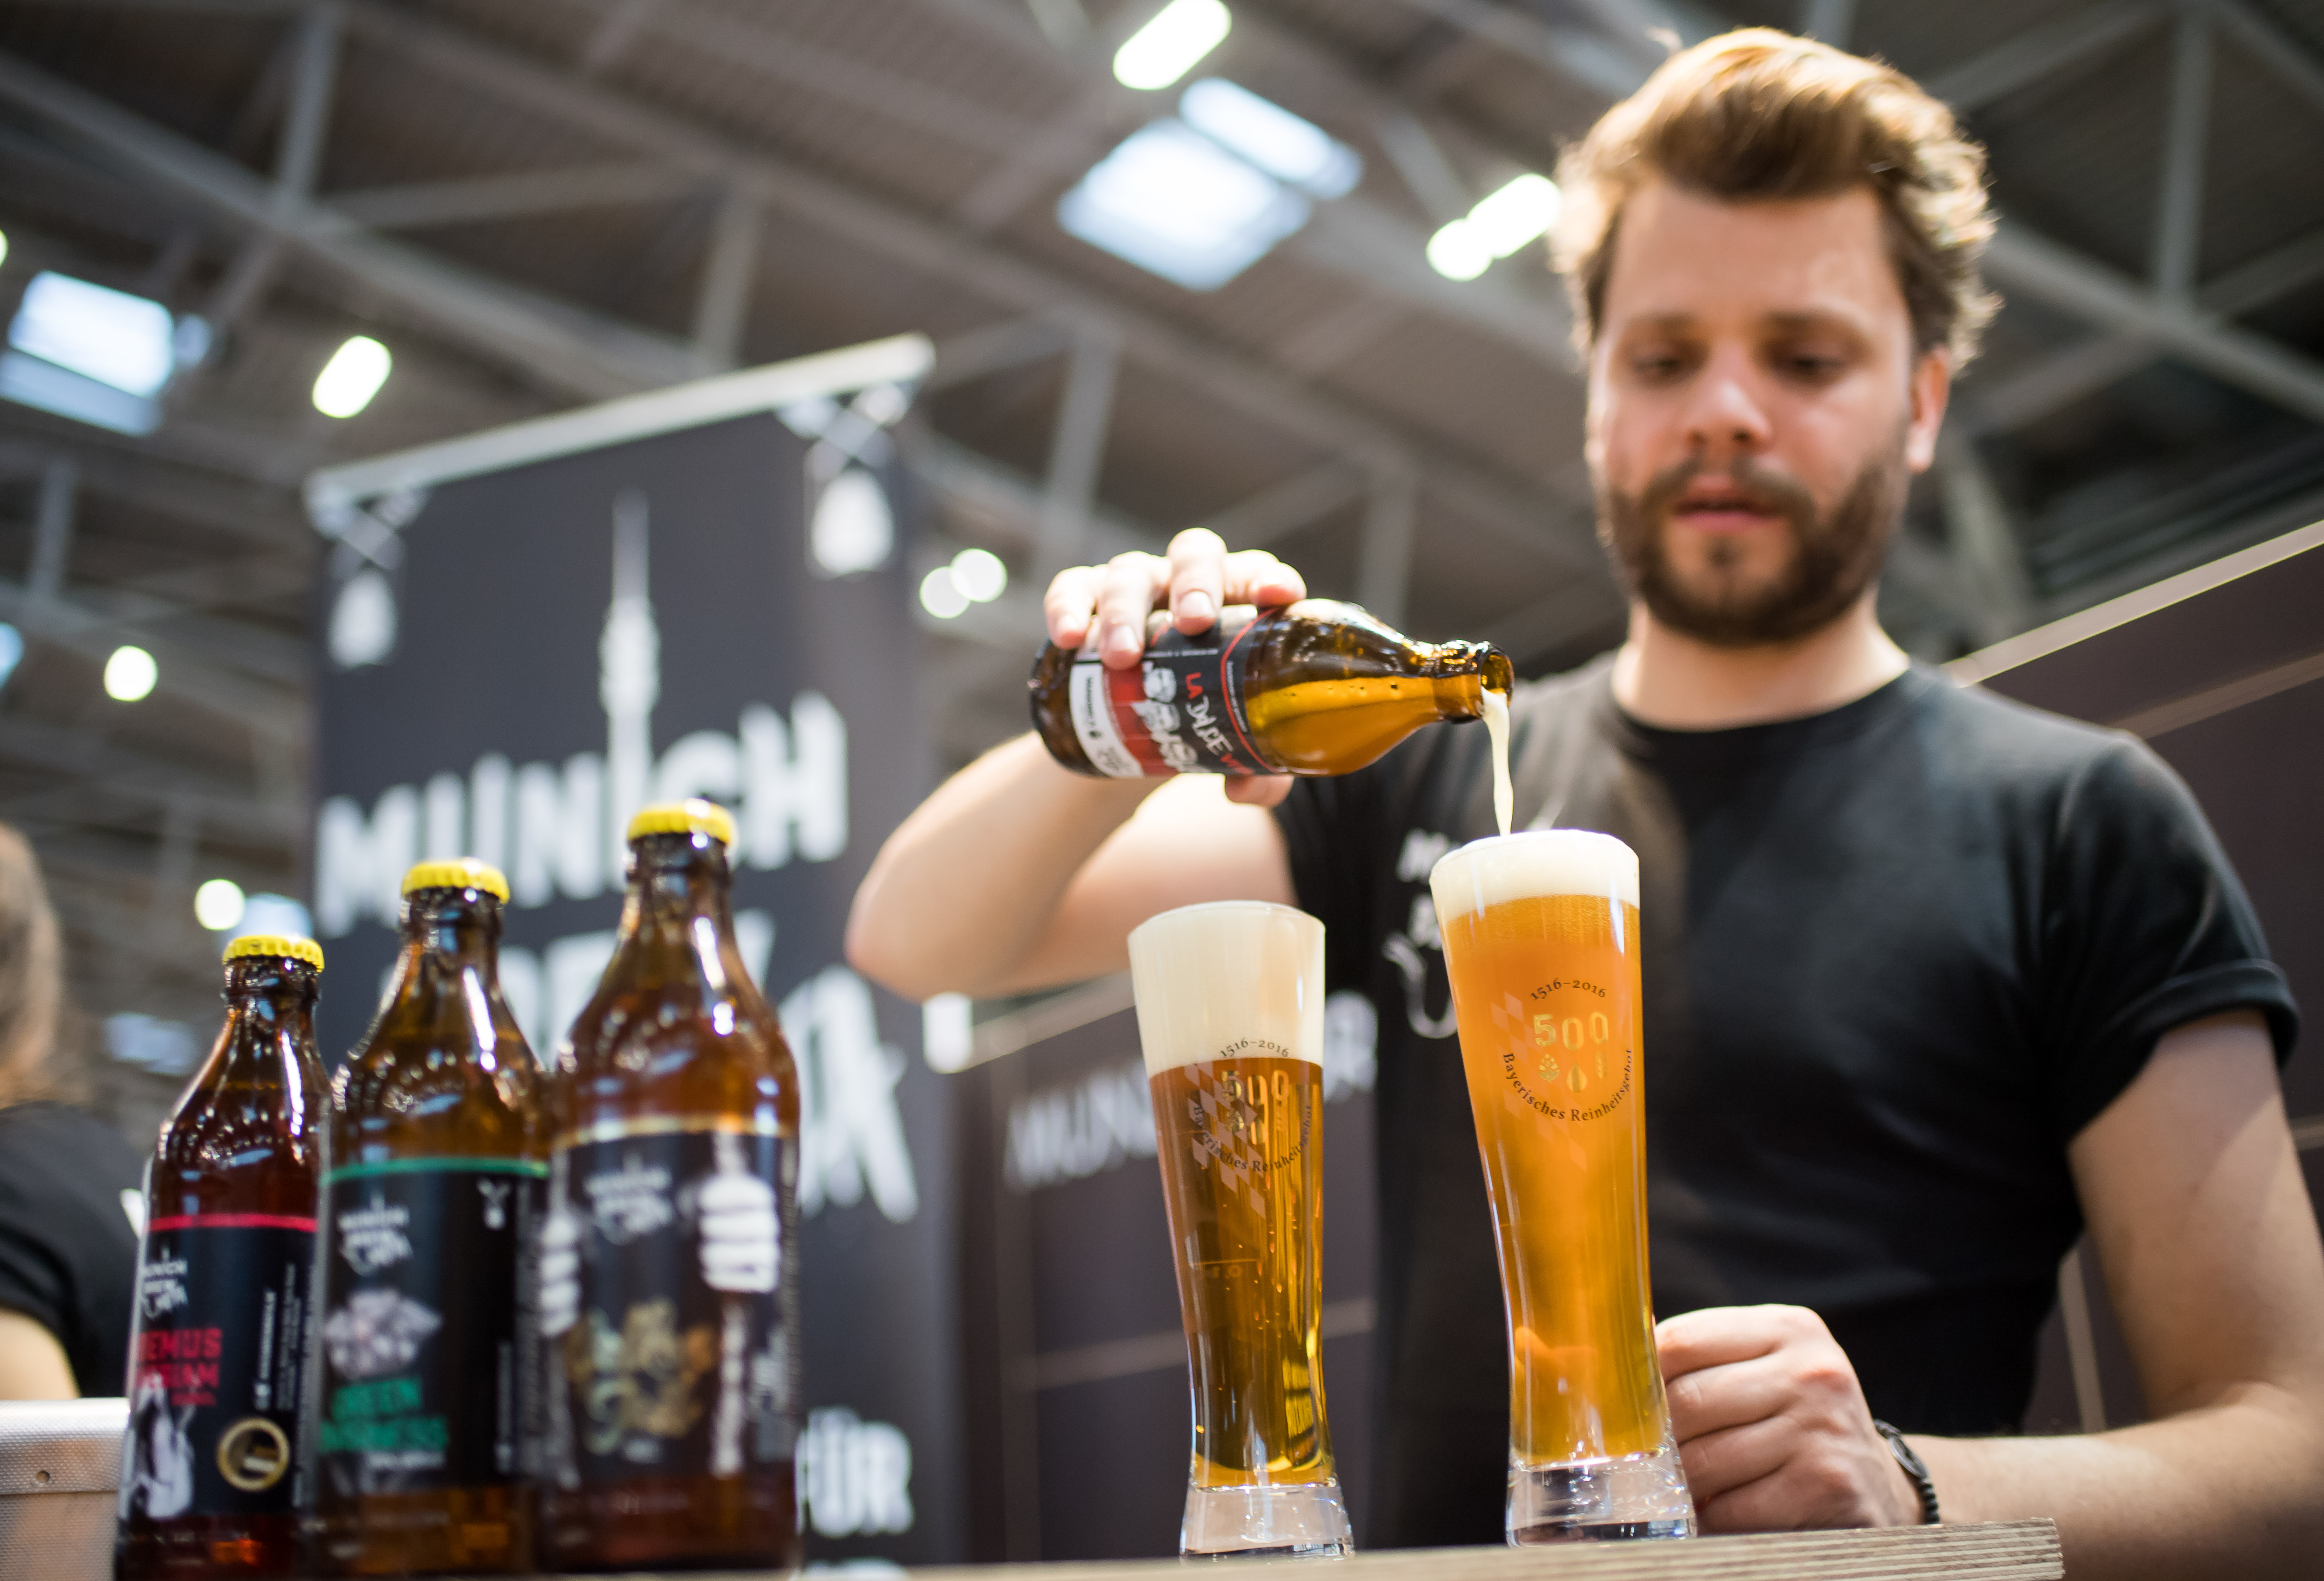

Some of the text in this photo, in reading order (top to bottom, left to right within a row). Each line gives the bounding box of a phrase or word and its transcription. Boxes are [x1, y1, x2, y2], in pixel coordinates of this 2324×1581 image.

[1185, 672, 1203, 699] LA
[315, 689, 850, 940] MUNICH
[1530, 977, 1606, 1000] 1516-2016
[1220, 1038, 1290, 1058] 1516-2016
[1533, 1011, 1609, 1052] 500
[1503, 1049, 1632, 1121] Bayerisches Reinheitsgebot
